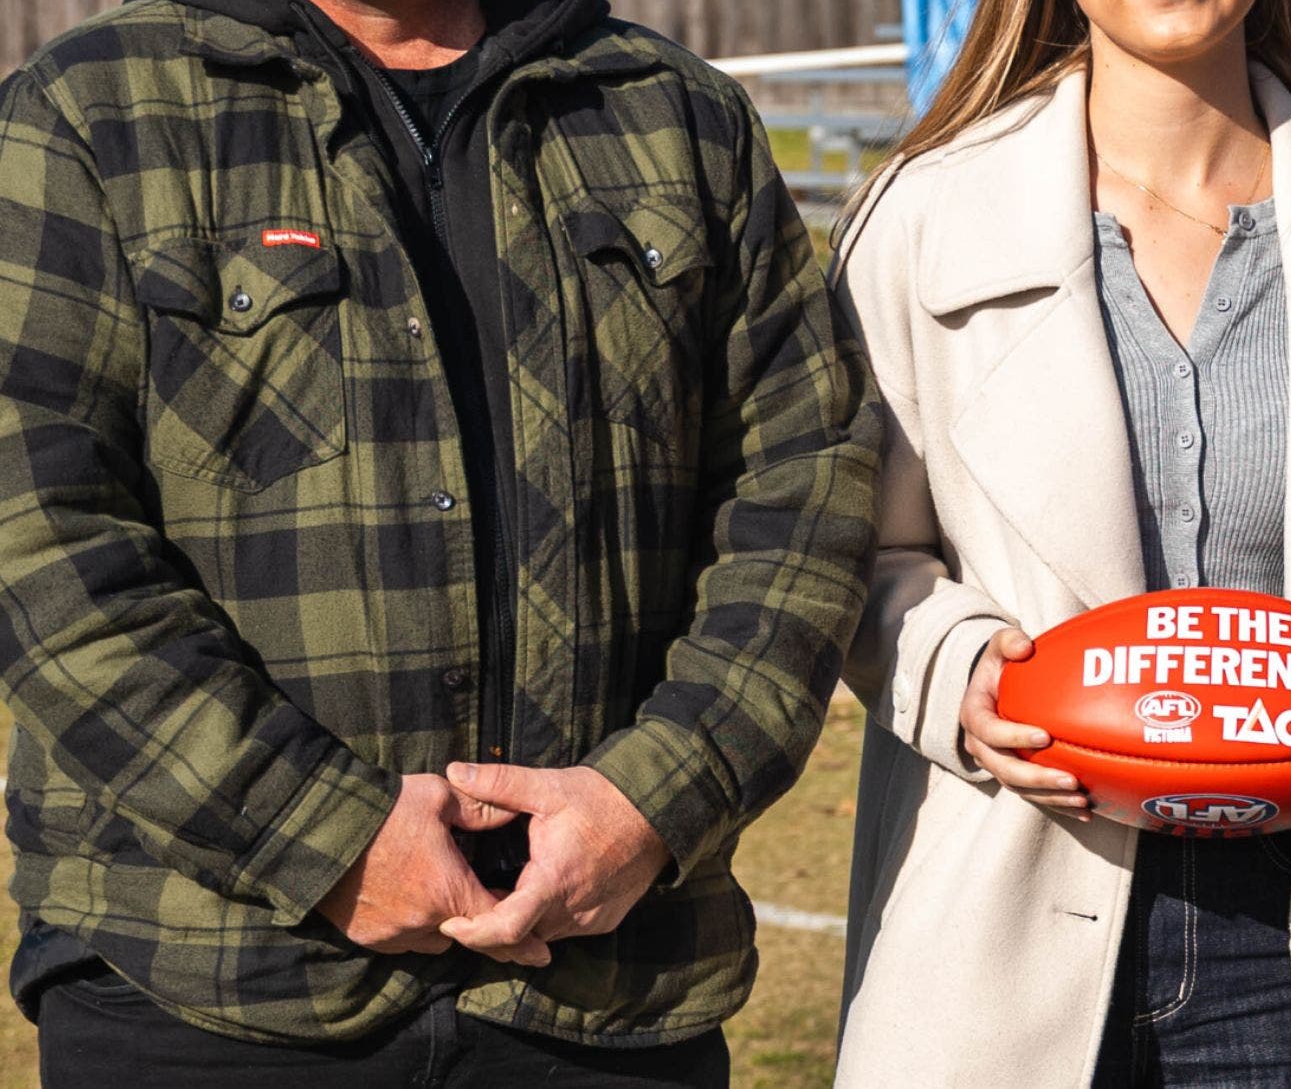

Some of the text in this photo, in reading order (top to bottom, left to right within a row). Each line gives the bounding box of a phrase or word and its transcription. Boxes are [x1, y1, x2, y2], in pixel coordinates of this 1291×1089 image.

[1146, 605, 1204, 641] BE
[1141, 697, 1196, 718] AFL
[1155, 798, 1268, 823] AFL
